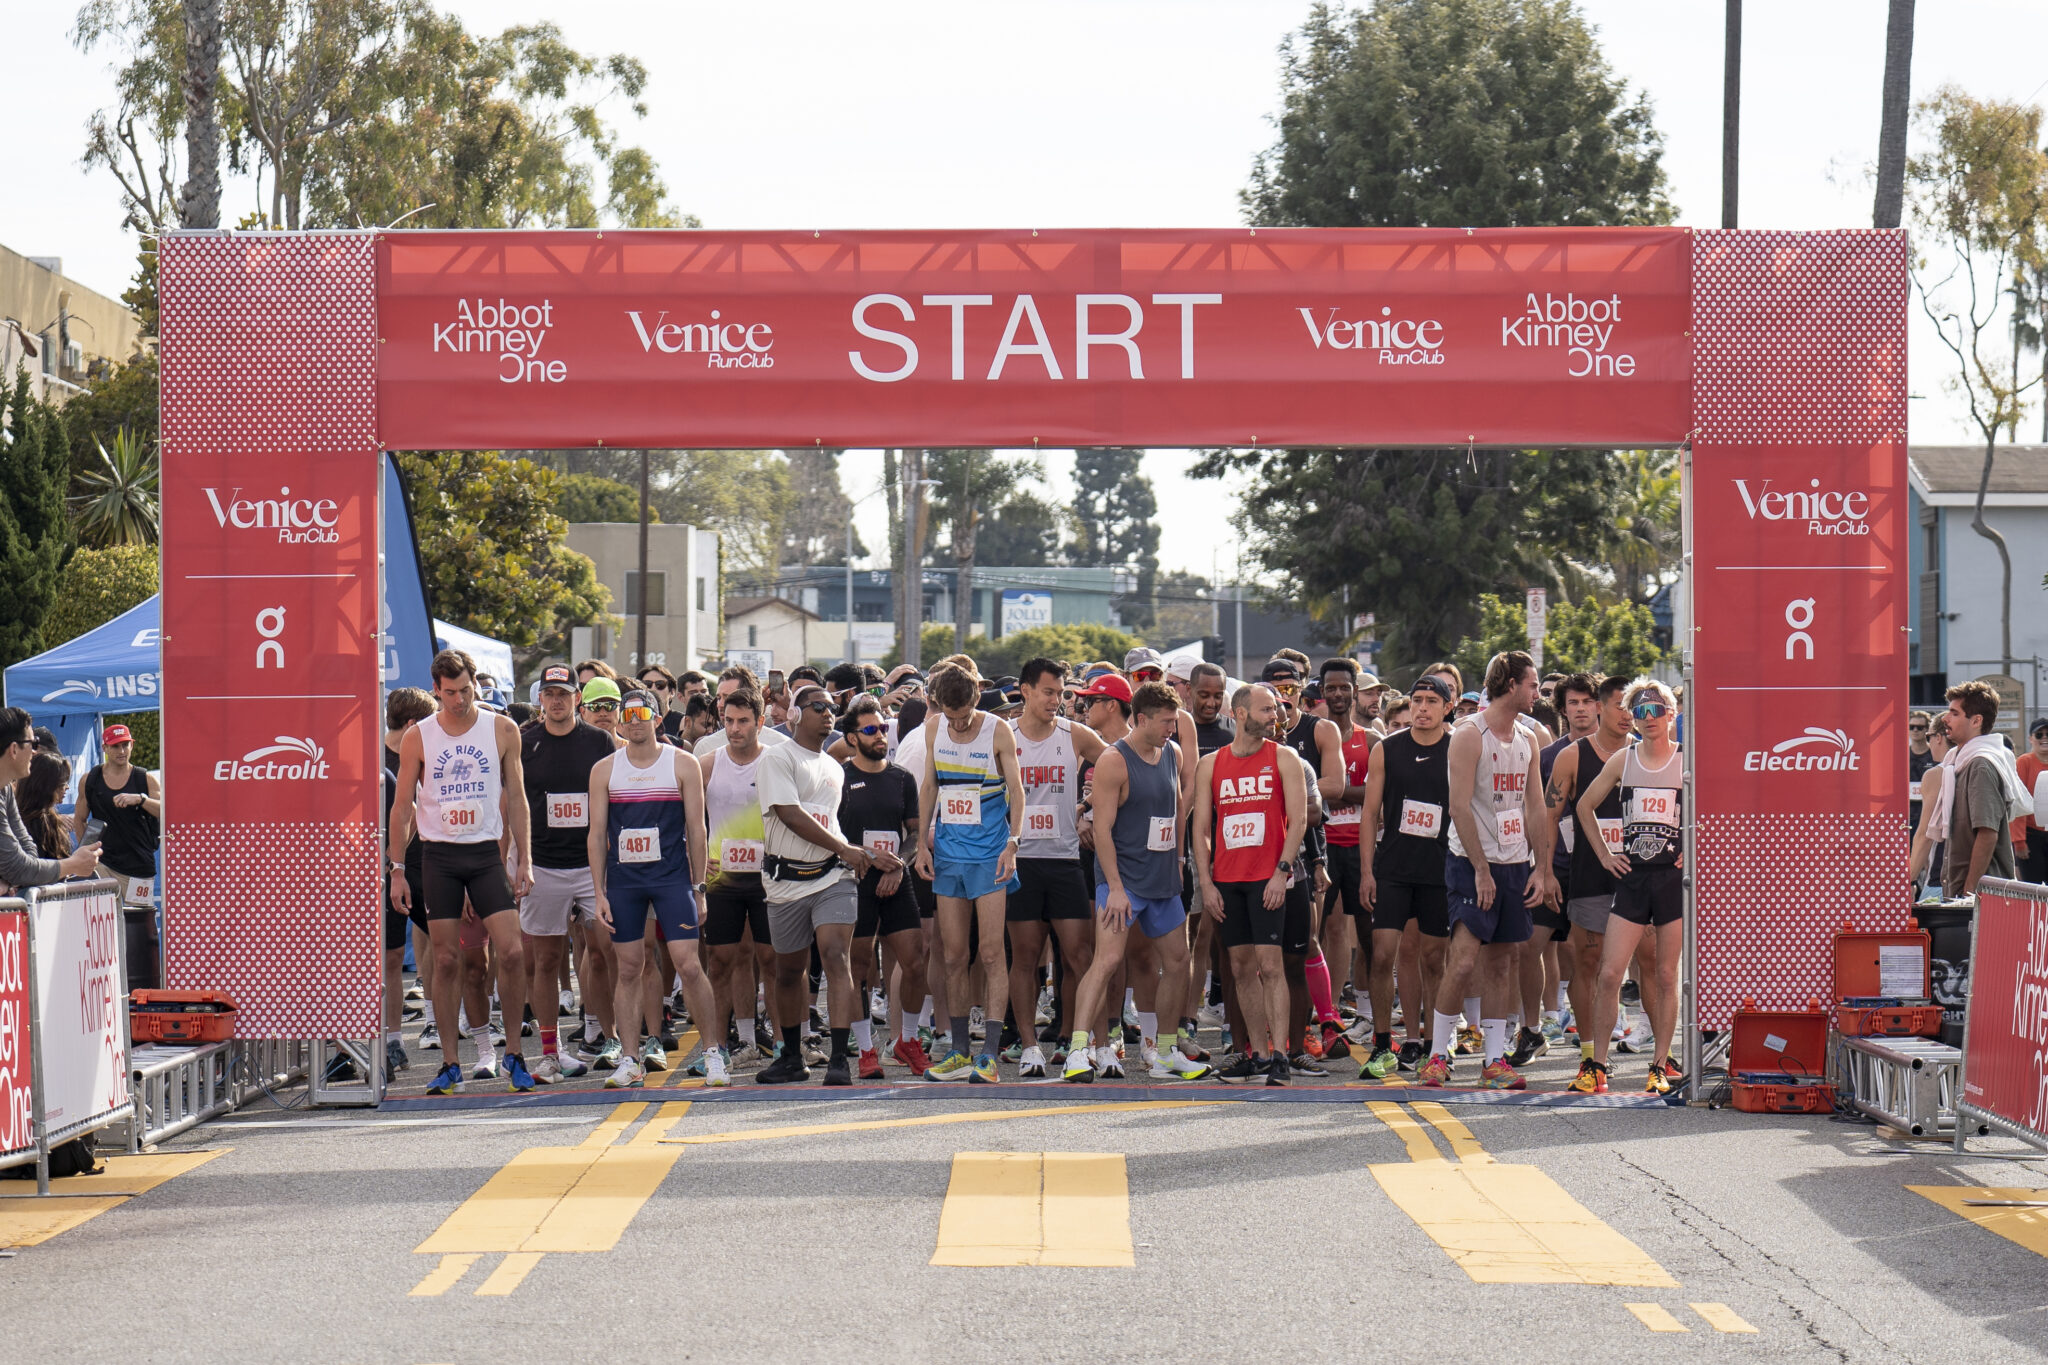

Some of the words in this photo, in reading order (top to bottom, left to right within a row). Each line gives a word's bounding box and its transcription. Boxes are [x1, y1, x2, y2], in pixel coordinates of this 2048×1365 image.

[458, 298, 553, 328] Abbot
[1526, 293, 1622, 323] Abbot
[434, 322, 545, 358] Kinney
[624, 310, 774, 354] Venice
[848, 293, 1222, 382] START
[1295, 306, 1445, 350] Venice
[1502, 316, 1613, 352] Kinney
[500, 352, 567, 383] One
[1568, 347, 1635, 377] One
[201, 486, 339, 529] Venice
[1731, 478, 1869, 520] Venice
[1007, 608, 1049, 621] JOLLY
[630, 651, 666, 665] 202
[106, 673, 162, 698] INS
[433, 749, 453, 779] BLUE
[456, 745, 490, 774] RIBBON
[969, 751, 989, 760] HOKA
[1744, 751, 1860, 772] Electrolit
[213, 757, 330, 782] Electrolit
[441, 781, 485, 796] SPORTS
[1220, 775, 1273, 799] ARC
[554, 803, 582, 818] 505
[947, 799, 973, 815] 562
[1220, 796, 1242, 805] racing
[1243, 794, 1272, 803] project
[1641, 798, 1667, 813] 129
[449, 809, 475, 826] 301
[1029, 814, 1054, 830] 199
[1407, 810, 1434, 828] 543
[1503, 818, 1521, 836] 545
[1232, 822, 1255, 839] 212
[626, 837, 651, 853] 487
[729, 847, 756, 863] 324
[136, 885, 149, 898] 98
[83, 895, 117, 969] Abbot
[79, 959, 117, 1042] Kinney
[2012, 960, 2048, 1050] Kinne
[0, 1000, 20, 1078] ey
